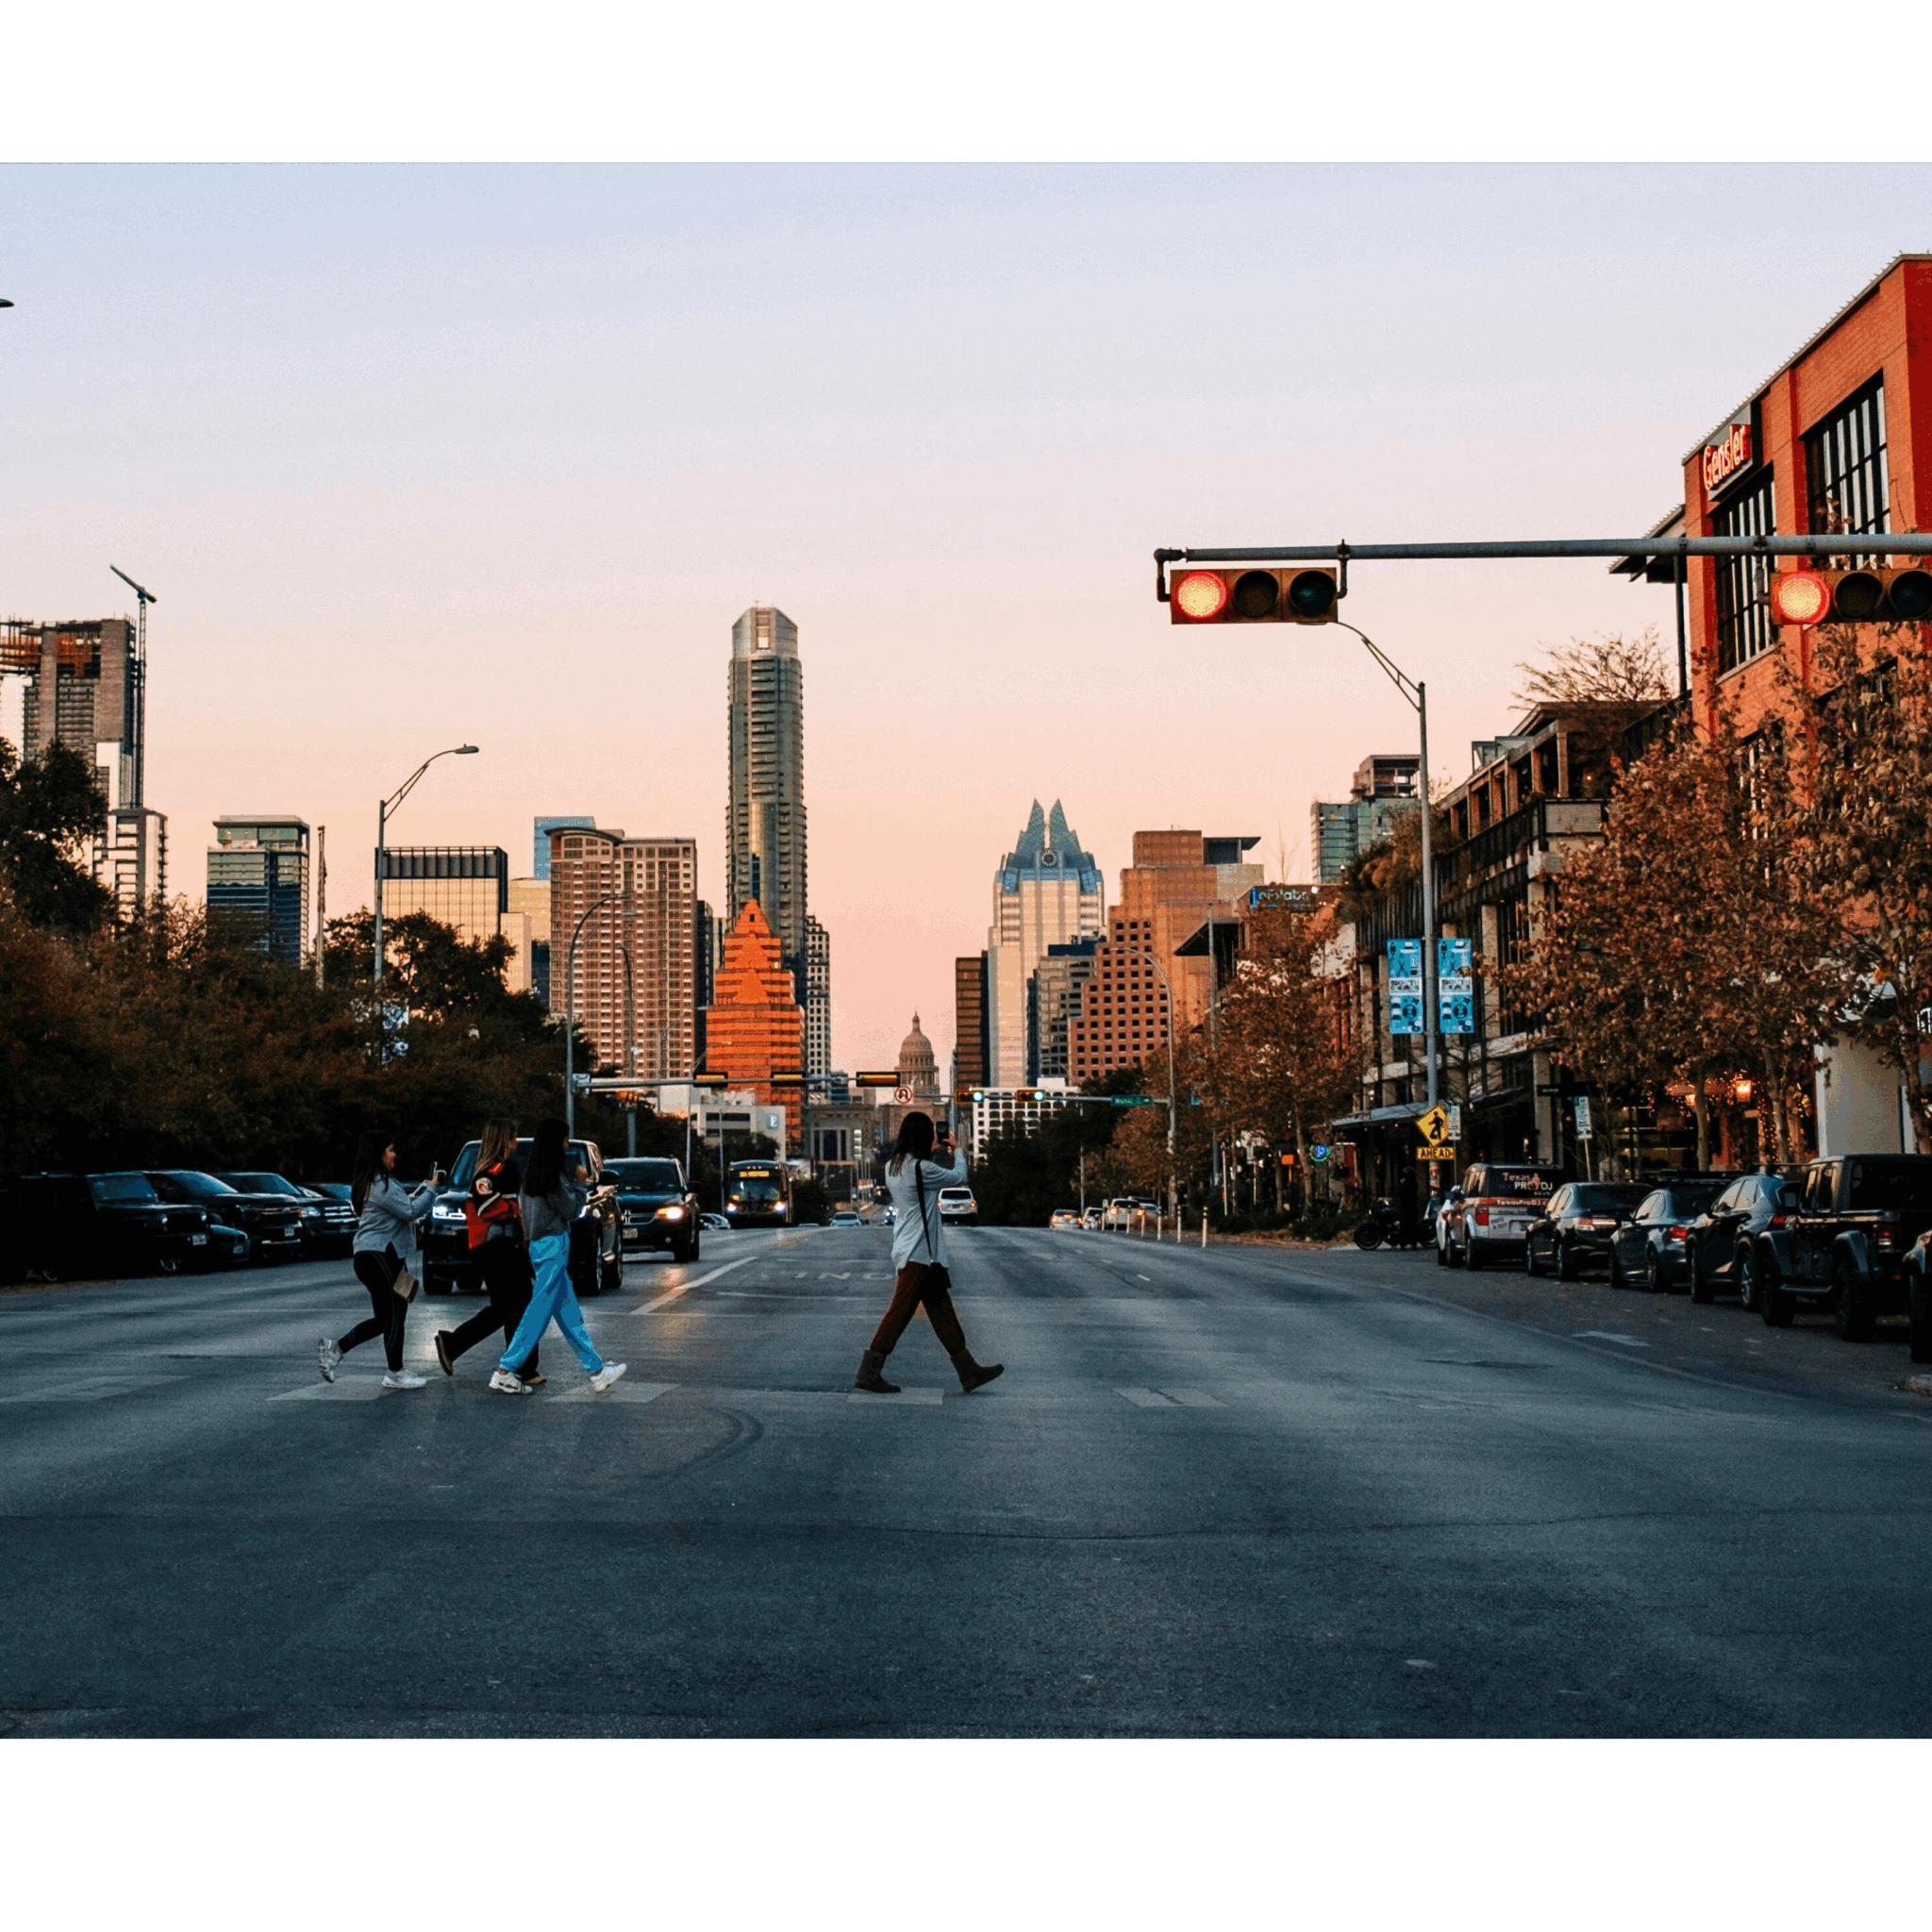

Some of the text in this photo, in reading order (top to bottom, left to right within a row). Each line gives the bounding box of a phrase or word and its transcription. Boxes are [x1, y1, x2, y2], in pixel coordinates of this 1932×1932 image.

[1703, 425, 1746, 491] Gensler
[1420, 1148, 1451, 1158] AHEAD
[1502, 1172, 1530, 1181] Texas
[1541, 1181, 1553, 1191] DJ
